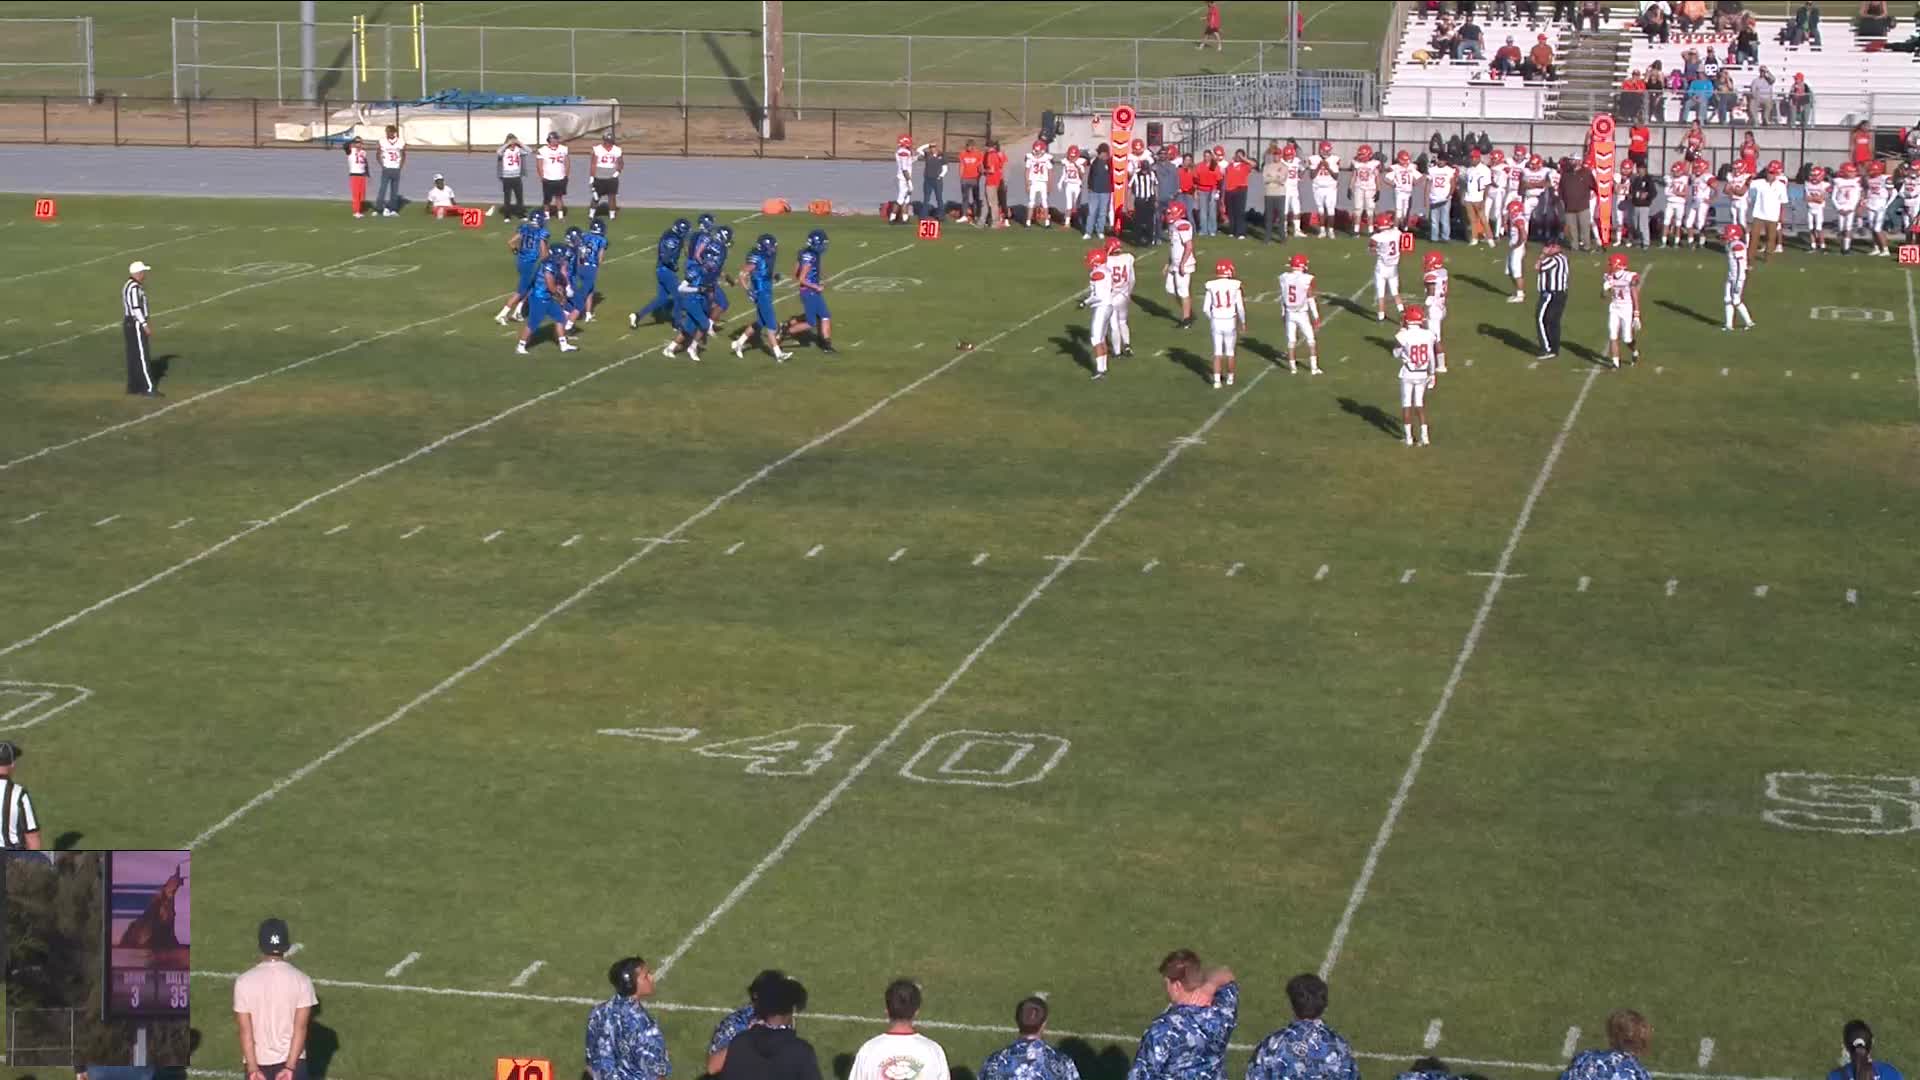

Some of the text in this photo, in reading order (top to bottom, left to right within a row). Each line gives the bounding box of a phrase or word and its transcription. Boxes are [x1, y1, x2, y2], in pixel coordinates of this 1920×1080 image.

[36, 200, 51, 216] 10
[463, 210, 479, 225] 20
[920, 222, 936, 237] 30
[1389, 240, 1397, 256] 3
[1900, 247, 1917, 262] 50
[1111, 264, 1128, 283] 54
[1215, 290, 1231, 308] 11
[1288, 285, 1297, 303] 5
[1410, 343, 1428, 365] 88
[131, 985, 140, 1009] 3
[170, 985, 188, 1009] 35
